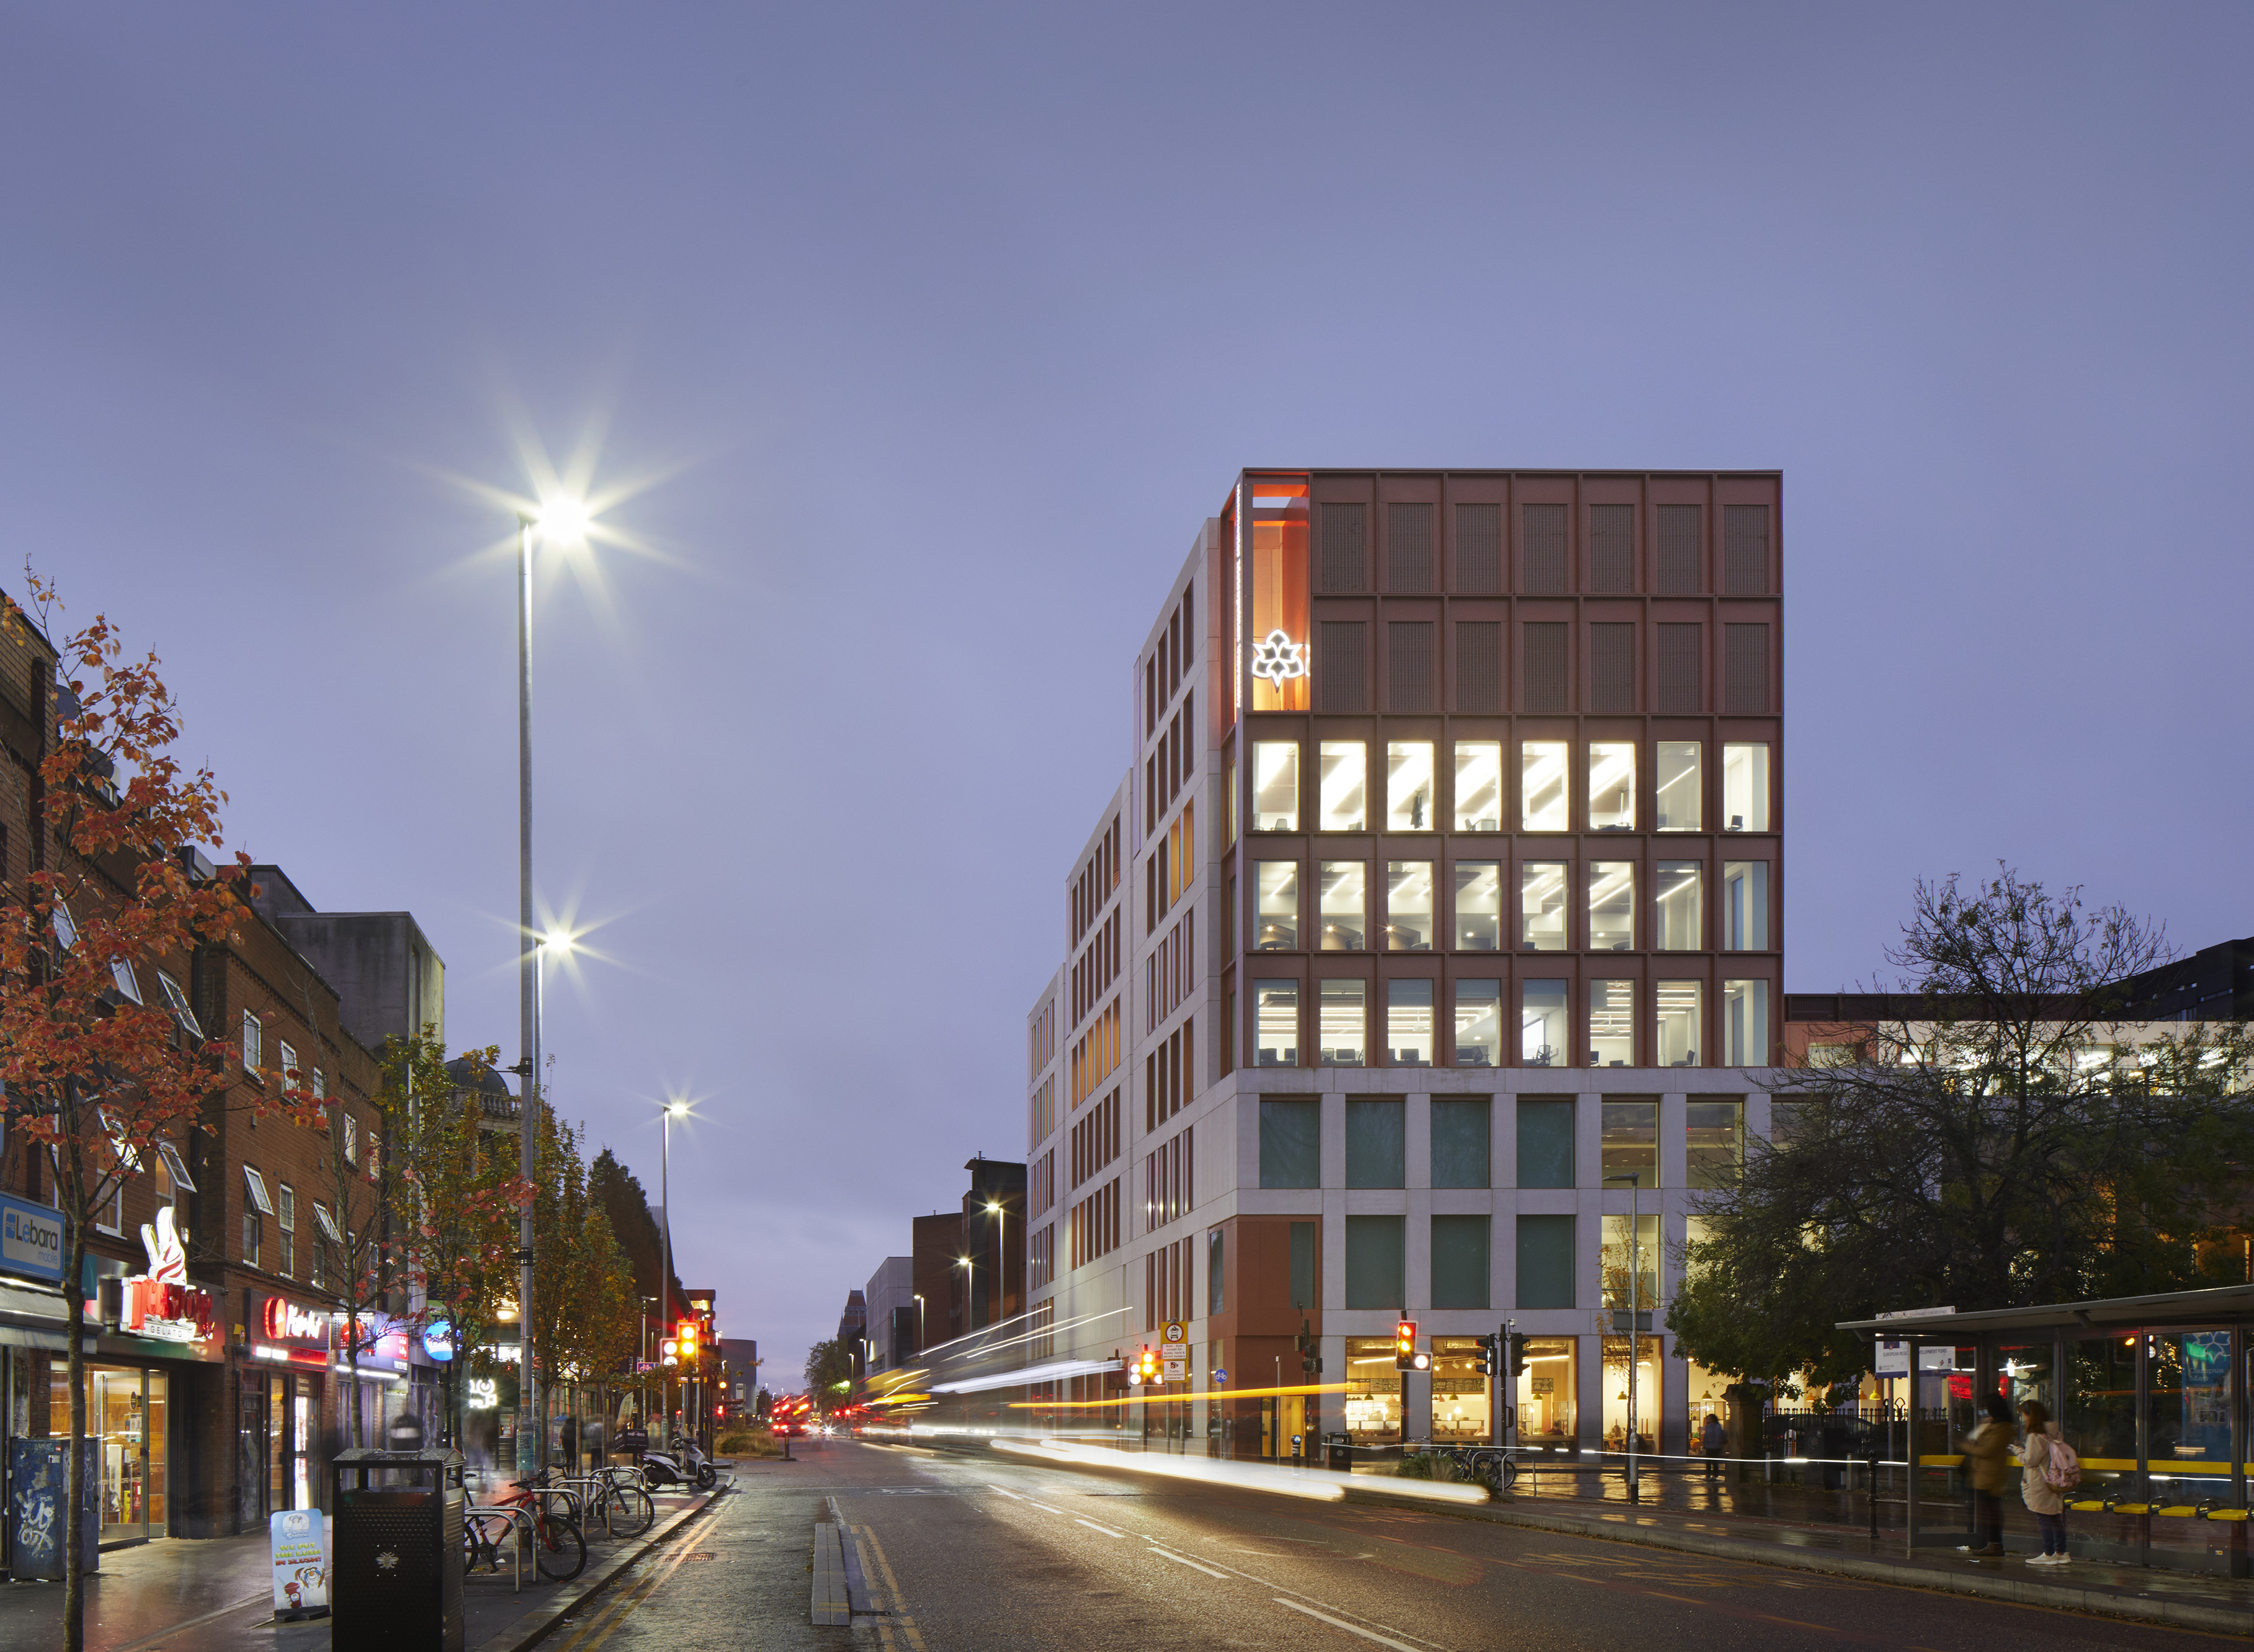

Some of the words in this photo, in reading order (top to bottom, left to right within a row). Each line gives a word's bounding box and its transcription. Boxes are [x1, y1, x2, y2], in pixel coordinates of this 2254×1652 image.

[16, 1215, 58, 1251] Lebara
[38, 1250, 58, 1265] mobile
[150, 1326, 182, 1337] GELATO
[2189, 1367, 2224, 1375] Campus
[288, 1556, 321, 1565] SLUSH!
